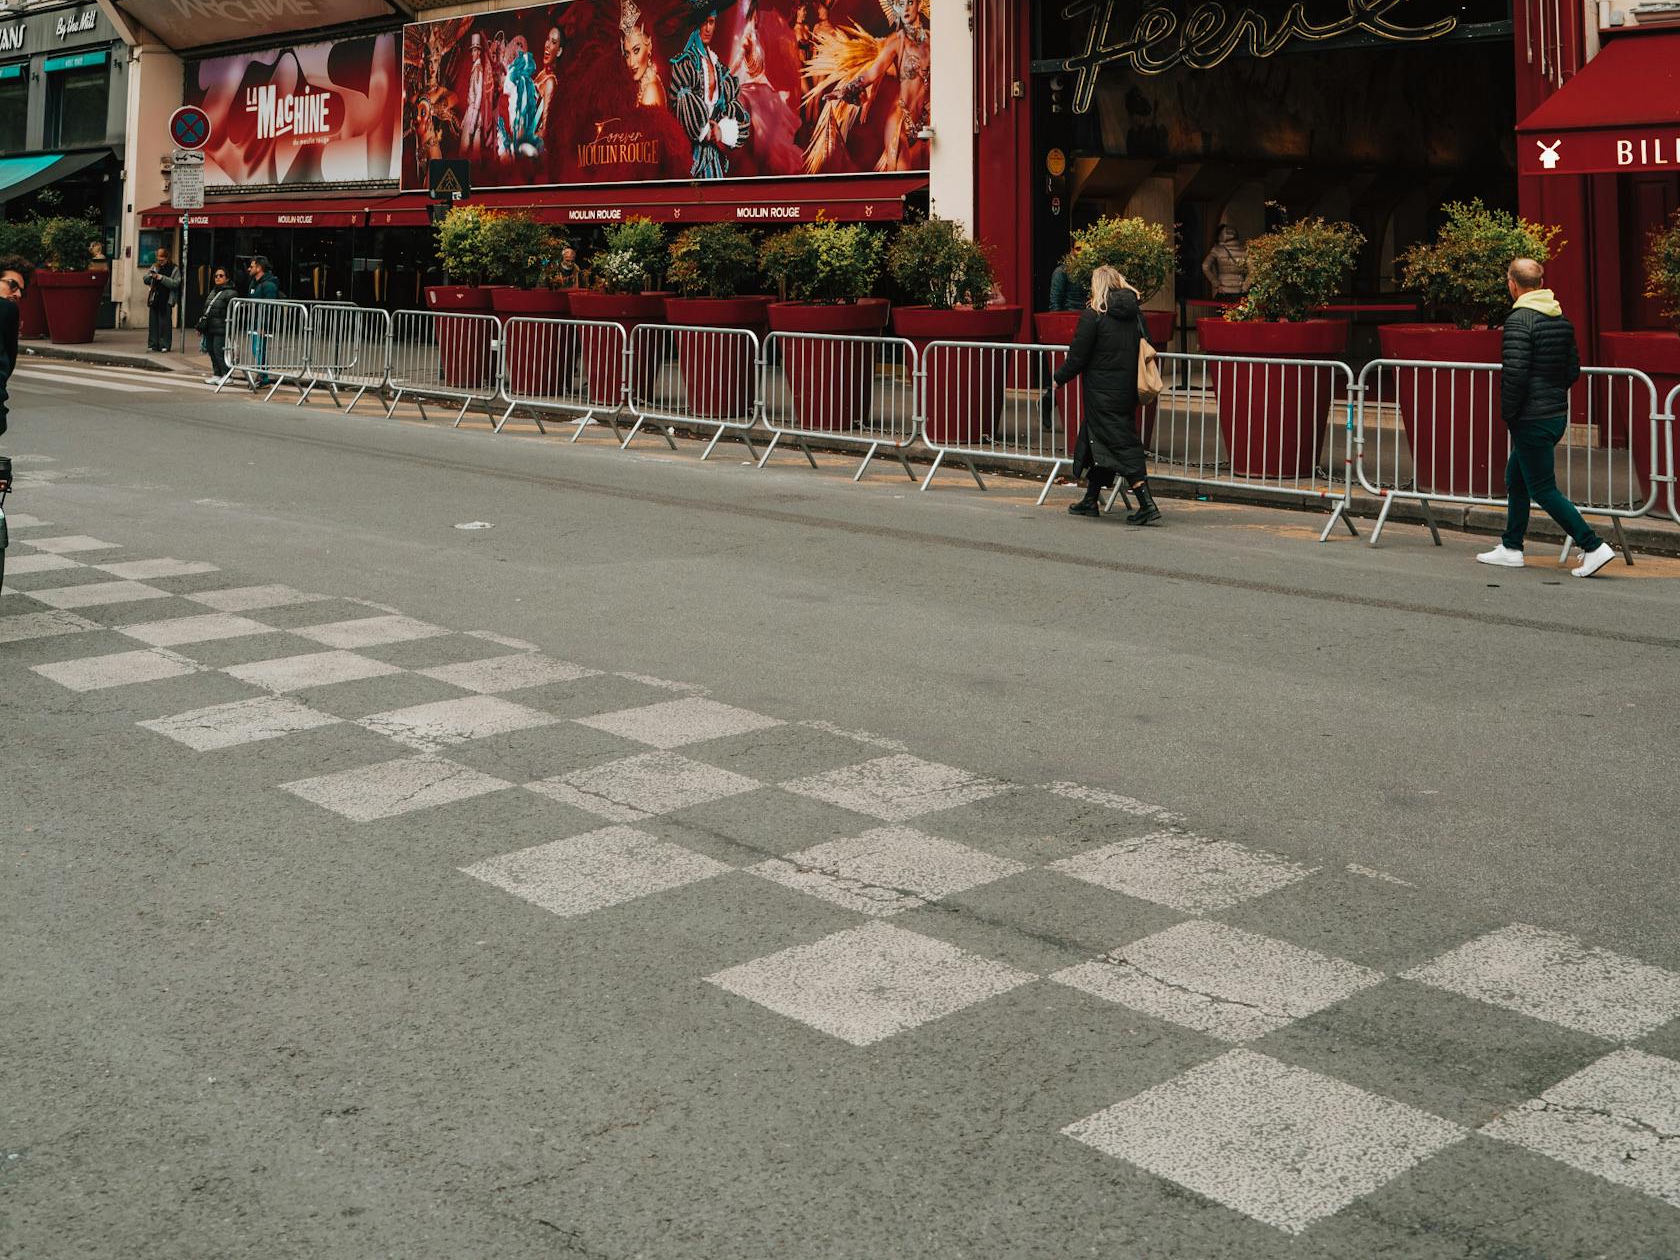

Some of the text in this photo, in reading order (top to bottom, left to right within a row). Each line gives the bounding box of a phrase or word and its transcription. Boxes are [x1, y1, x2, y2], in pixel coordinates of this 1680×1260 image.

[0, 24, 26, 51] ANS
[56, 9, 97, 41] By the Mill
[589, 117, 645, 144] Forever
[577, 139, 659, 168] MOULIN ROUGE
[568, 209, 622, 220] MOULIN ROUGE
[736, 206, 800, 218] MOULIN ROUGE
